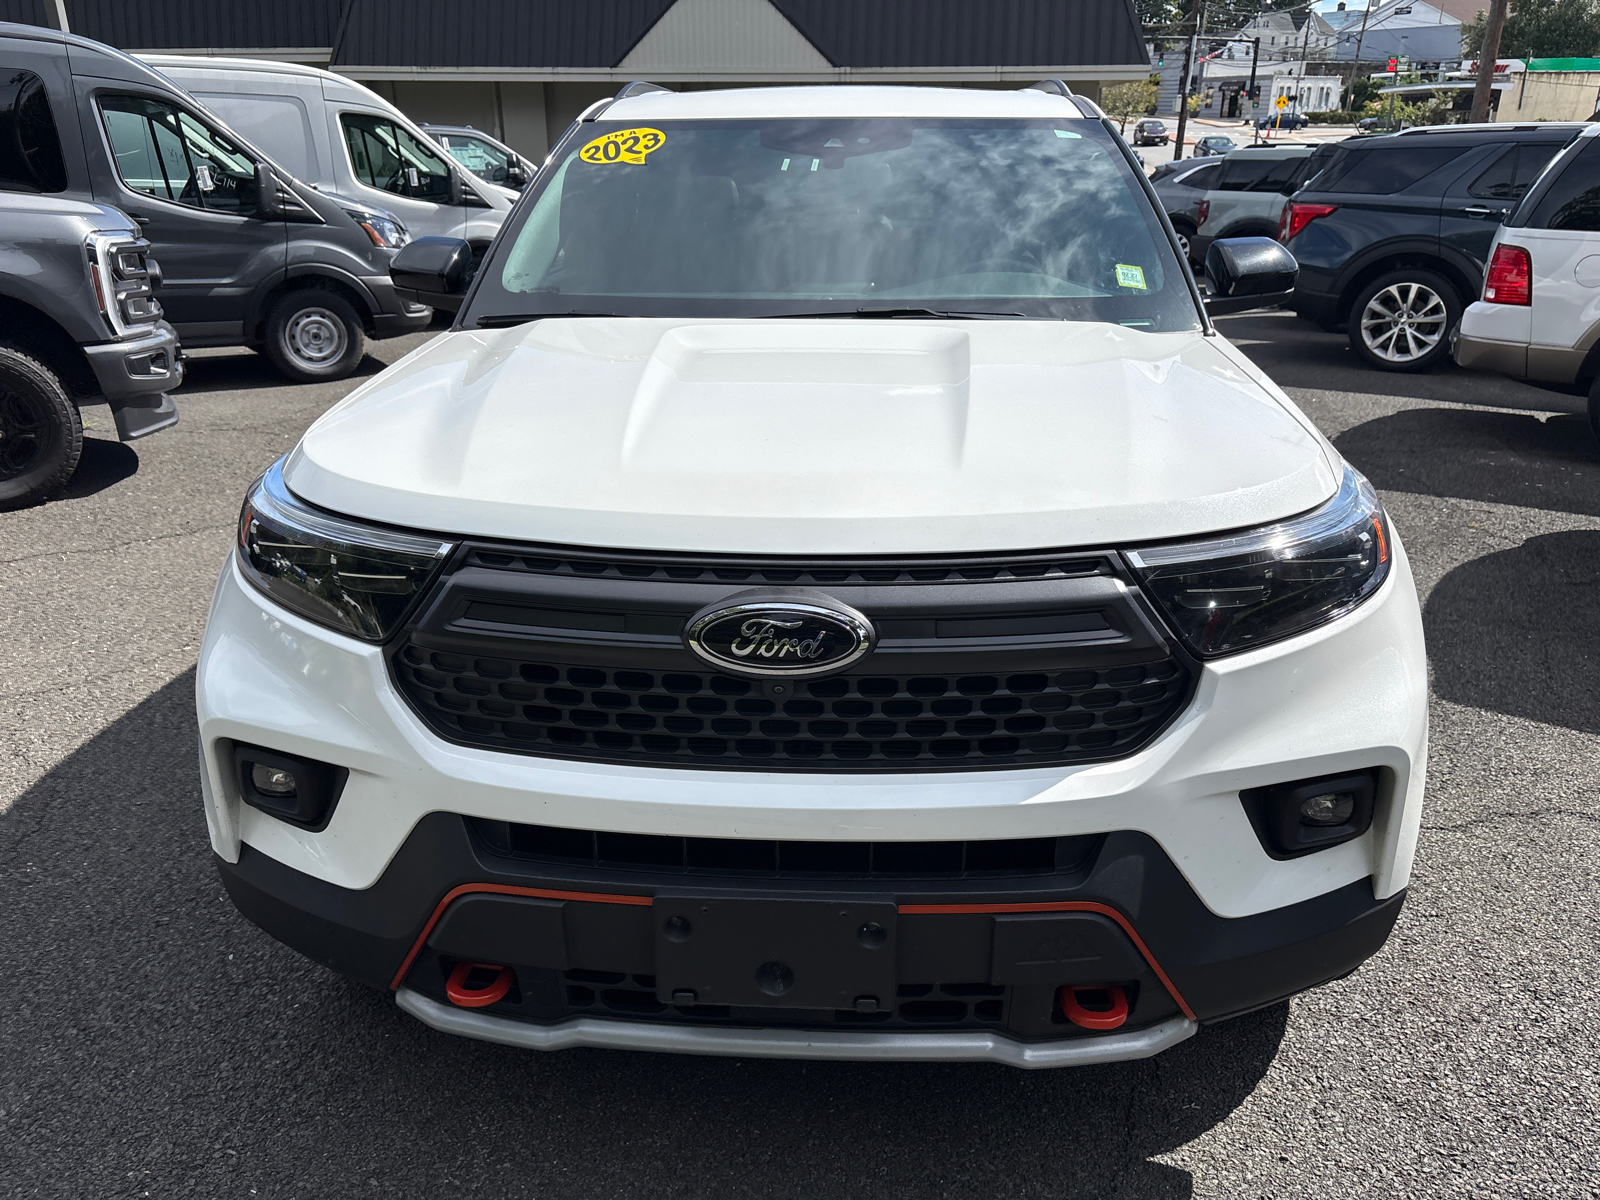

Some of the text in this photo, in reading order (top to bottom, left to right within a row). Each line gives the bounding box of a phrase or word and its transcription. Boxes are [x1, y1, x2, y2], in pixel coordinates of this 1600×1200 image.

[584, 133, 661, 161] 2023
[607, 132, 625, 141] I'M
[731, 618, 826, 659] Ford
